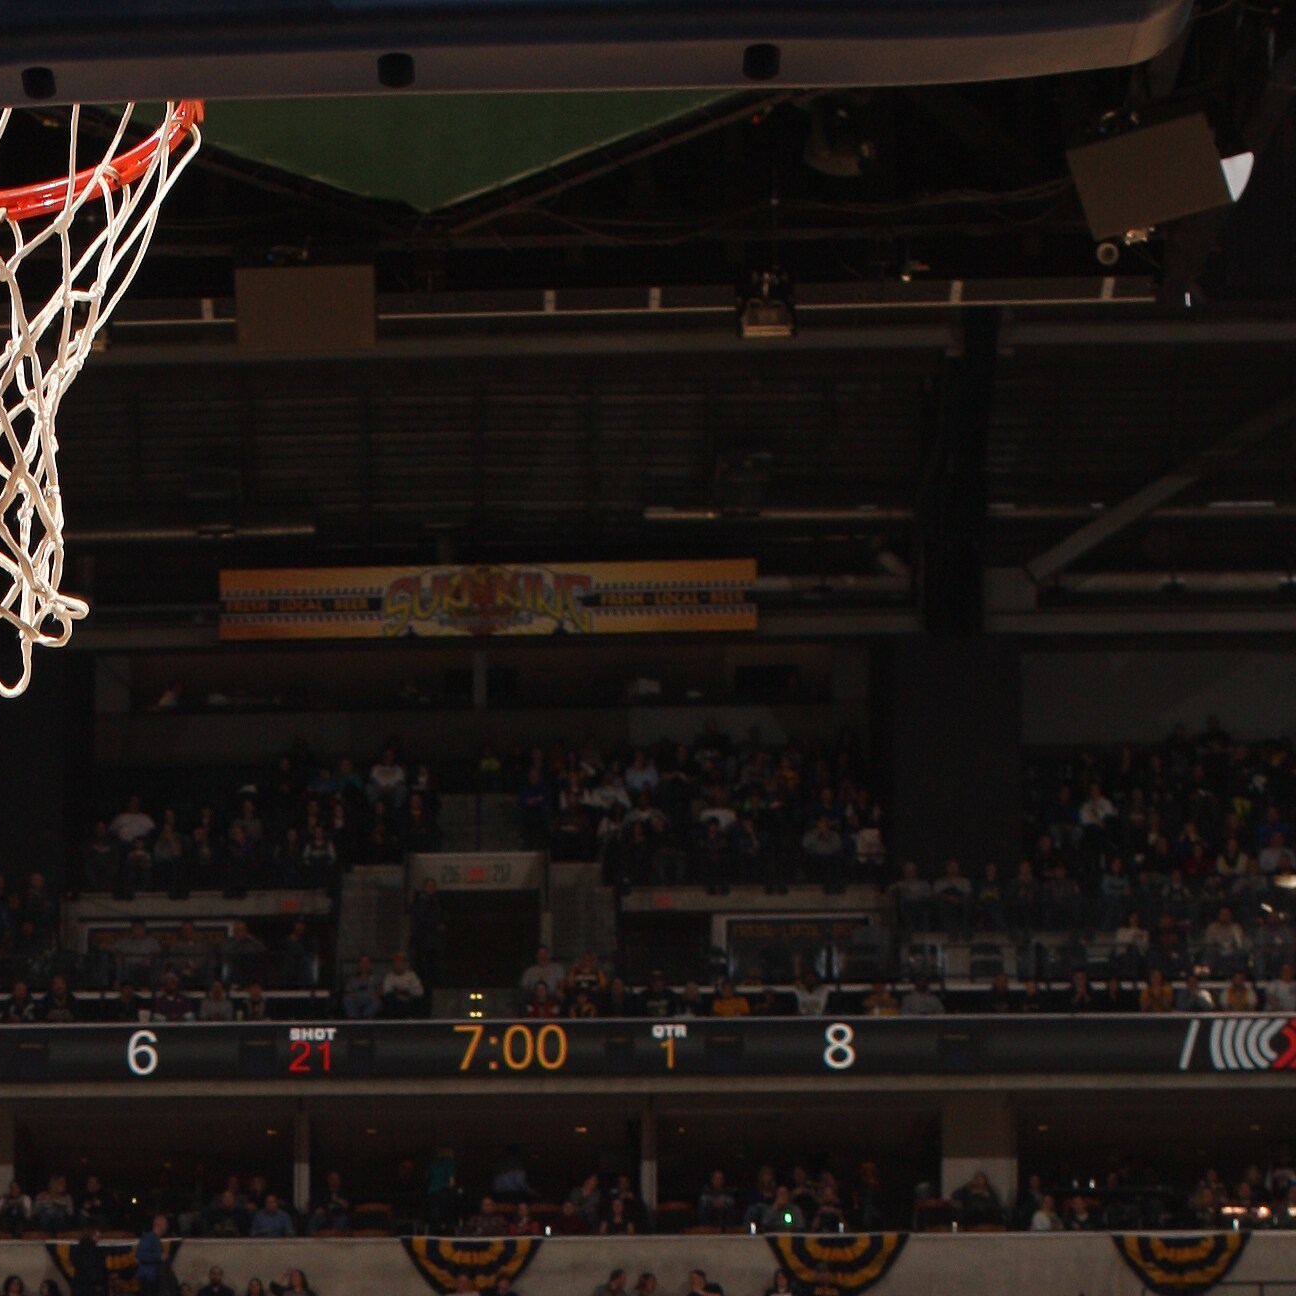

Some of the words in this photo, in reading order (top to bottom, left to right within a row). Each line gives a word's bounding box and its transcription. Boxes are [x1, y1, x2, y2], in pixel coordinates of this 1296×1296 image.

[289, 1027, 337, 1041] SHOT
[453, 1025, 568, 1071] 7:00
[652, 1026, 687, 1039] QTR
[823, 1023, 856, 1069] 8
[126, 1030, 158, 1075] 6
[288, 1040, 332, 1072] 21
[659, 1040, 676, 1069] 1
